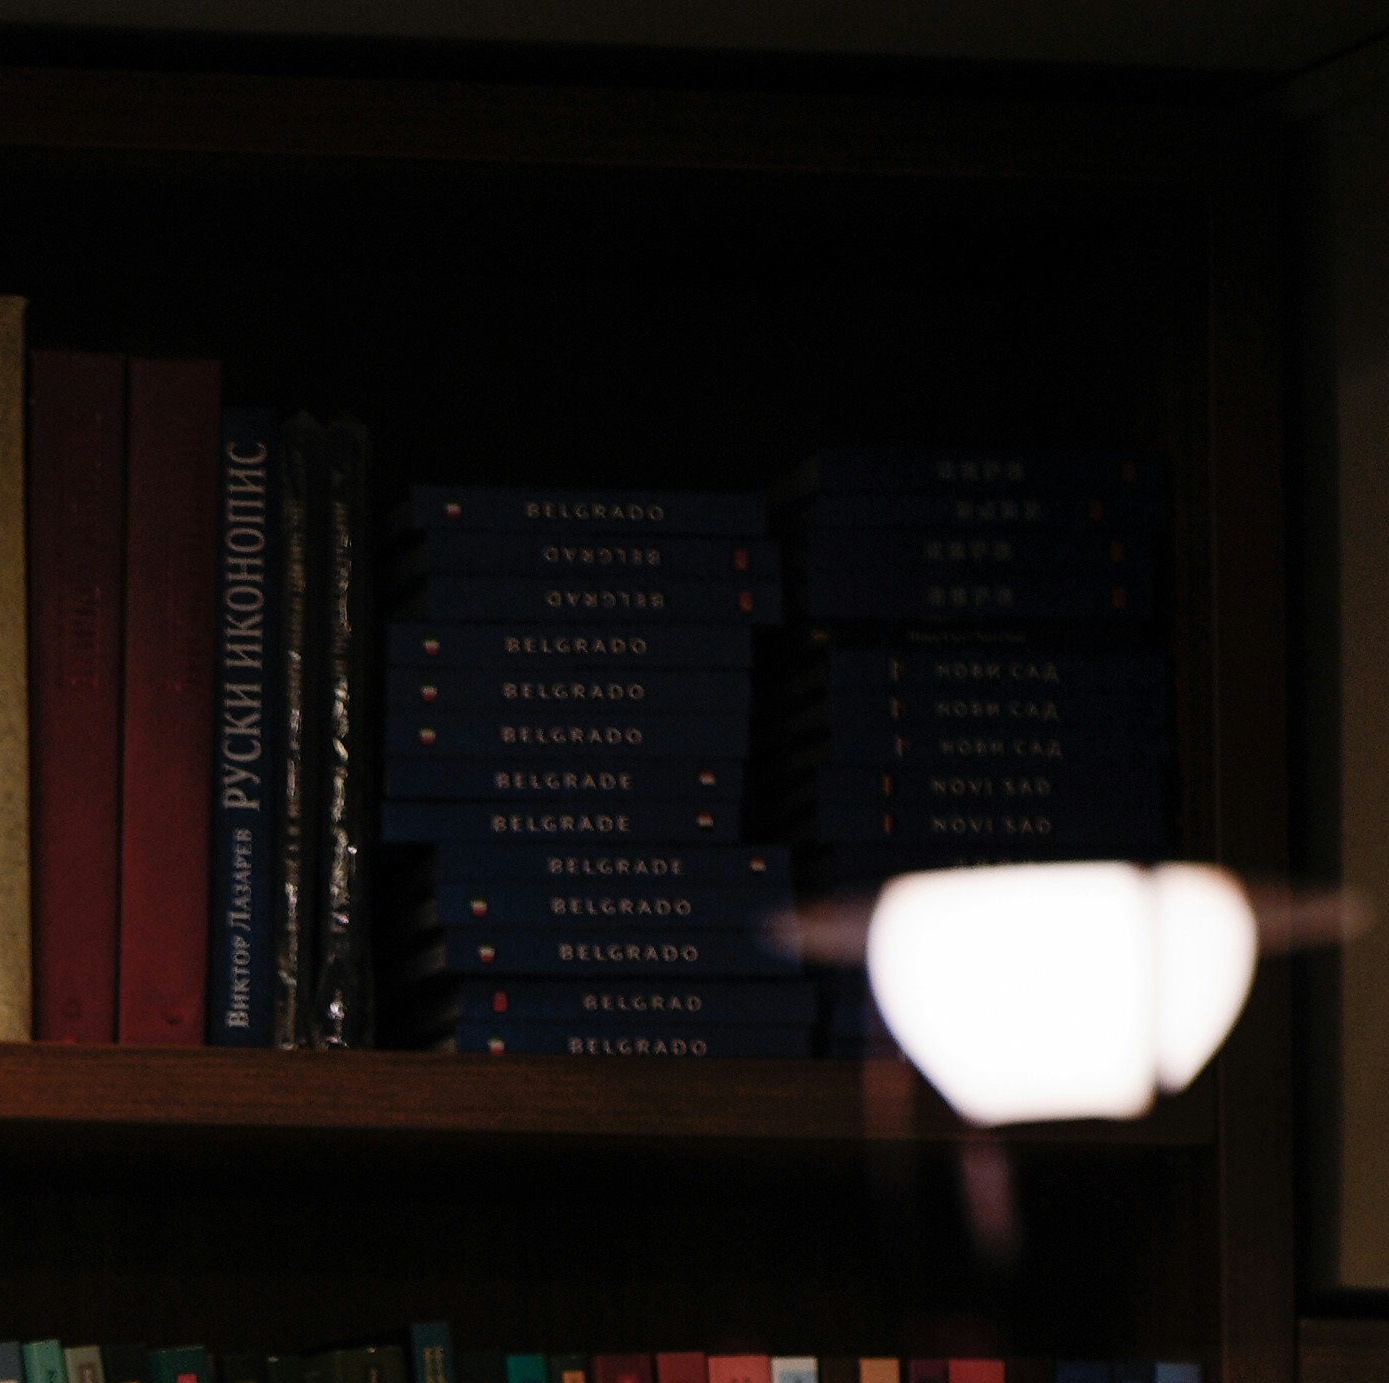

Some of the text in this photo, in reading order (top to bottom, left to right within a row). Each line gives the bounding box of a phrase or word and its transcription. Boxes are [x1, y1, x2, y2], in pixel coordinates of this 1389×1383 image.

[524, 502, 665, 521] BELGRADO
[221, 439, 268, 813] РУСКИ ИКОНОПИС
[504, 636, 648, 656] BELGRADO
[501, 682, 645, 701] BELGRADO
[499, 726, 643, 745] BELGRADO
[495, 771, 633, 790] BELGRADE
[933, 780, 993, 796] NOVI
[491, 814, 631, 833] BELGRADE
[933, 819, 993, 835] NOVI
[547, 858, 685, 875] BELGRADE
[550, 898, 692, 917] BELGRADO
[557, 943, 699, 962] BELGRADO
[567, 1037, 707, 1056] BELGRADO
